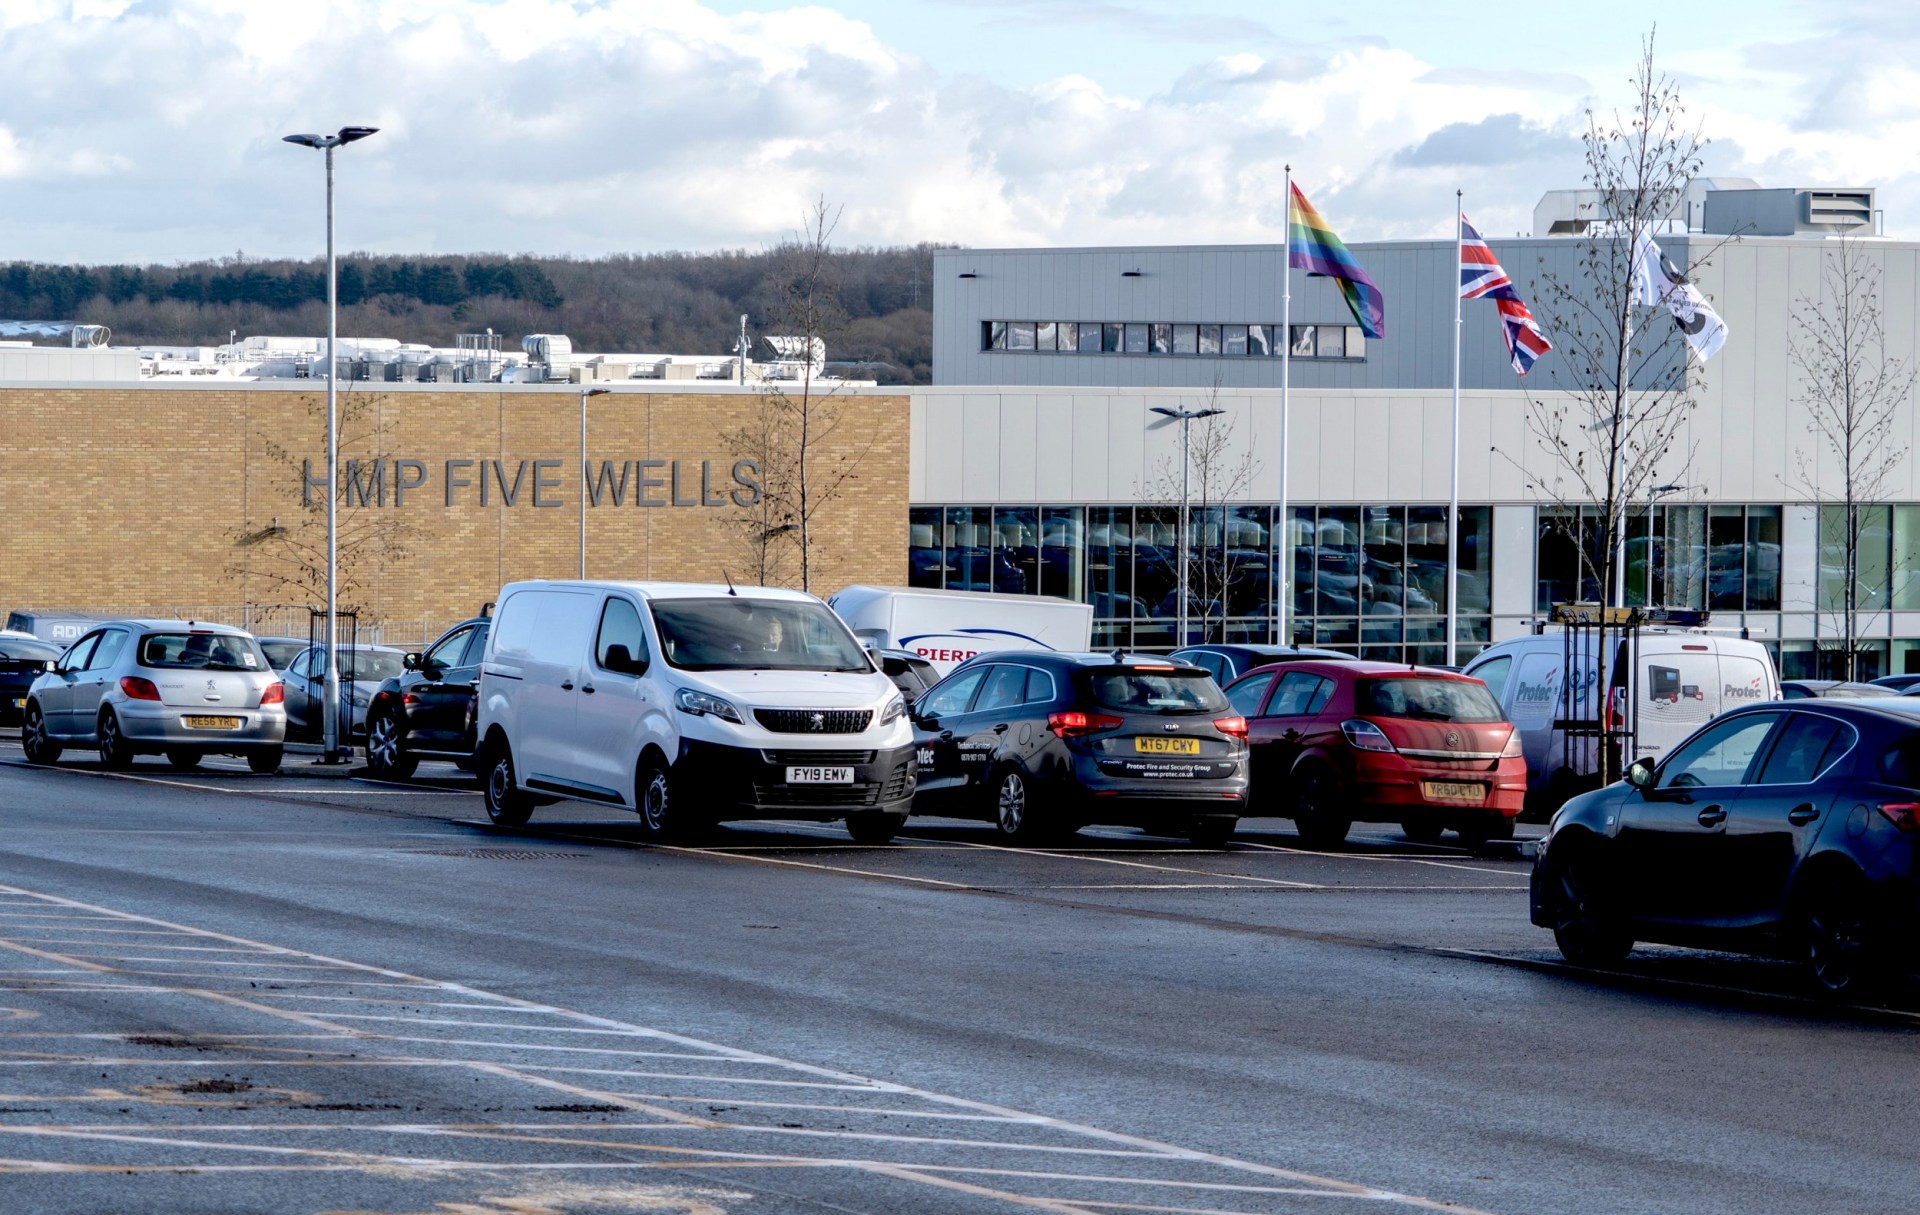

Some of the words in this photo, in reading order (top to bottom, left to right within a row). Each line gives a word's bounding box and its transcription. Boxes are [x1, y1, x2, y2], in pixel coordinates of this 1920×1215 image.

[303, 458, 428, 508] HMP
[445, 459, 564, 508] FIVE
[584, 459, 762, 508] WELLS
[1516, 681, 1552, 701] Protec
[1724, 684, 1761, 698] Protec
[191, 716, 216, 726] RE56
[219, 717, 236, 727] YRL
[957, 741, 974, 750] Technical
[975, 742, 991, 750] Services
[1140, 738, 1170, 750] MT67
[1171, 764, 1193, 772] Security
[794, 768, 821, 781] FY19
[824, 768, 847, 781] EMV
